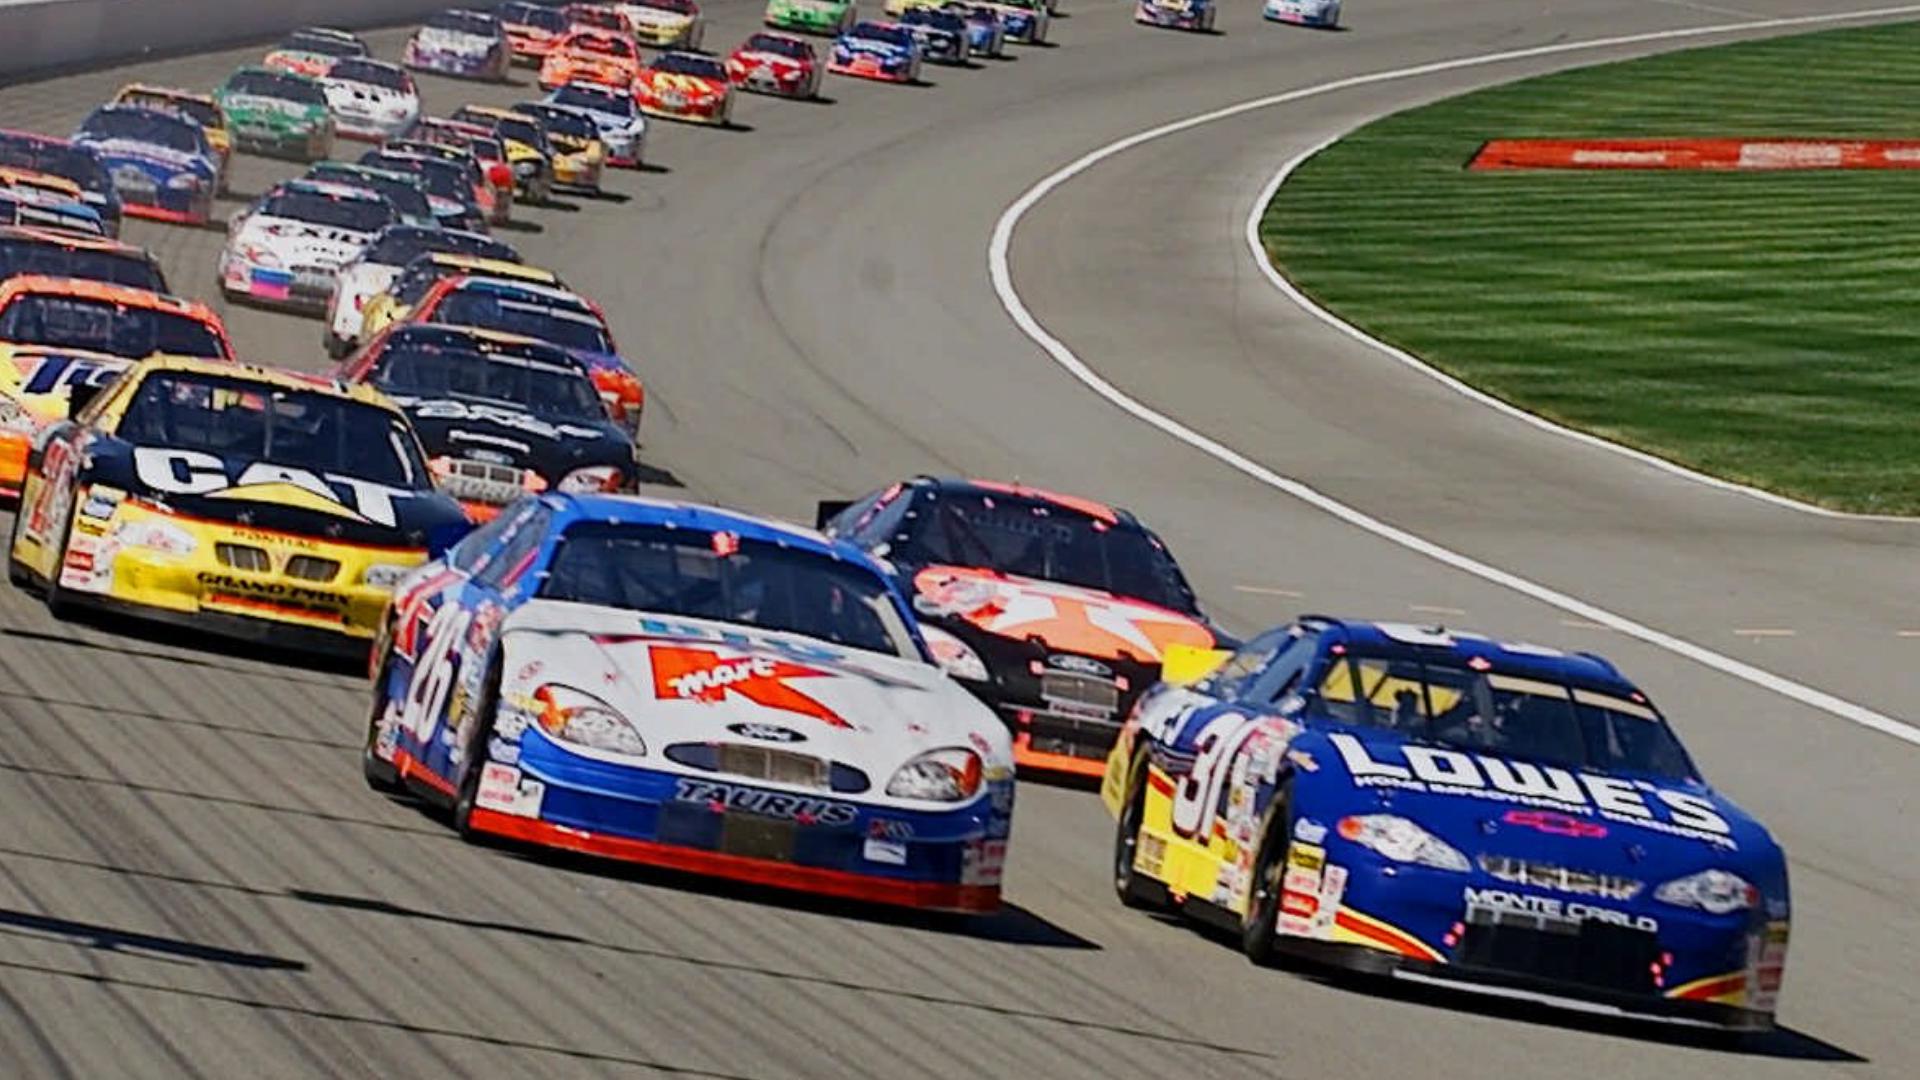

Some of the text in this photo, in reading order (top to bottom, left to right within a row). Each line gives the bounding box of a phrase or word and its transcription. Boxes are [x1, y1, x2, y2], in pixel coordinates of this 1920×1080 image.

[133, 447, 416, 528] CAT
[197, 571, 285, 595] GRAND
[674, 778, 859, 827] TAURUS
[1172, 711, 1264, 847] 31
[1329, 732, 1730, 834] LOWE'S
[1463, 886, 1659, 933] MONTE CARLO
